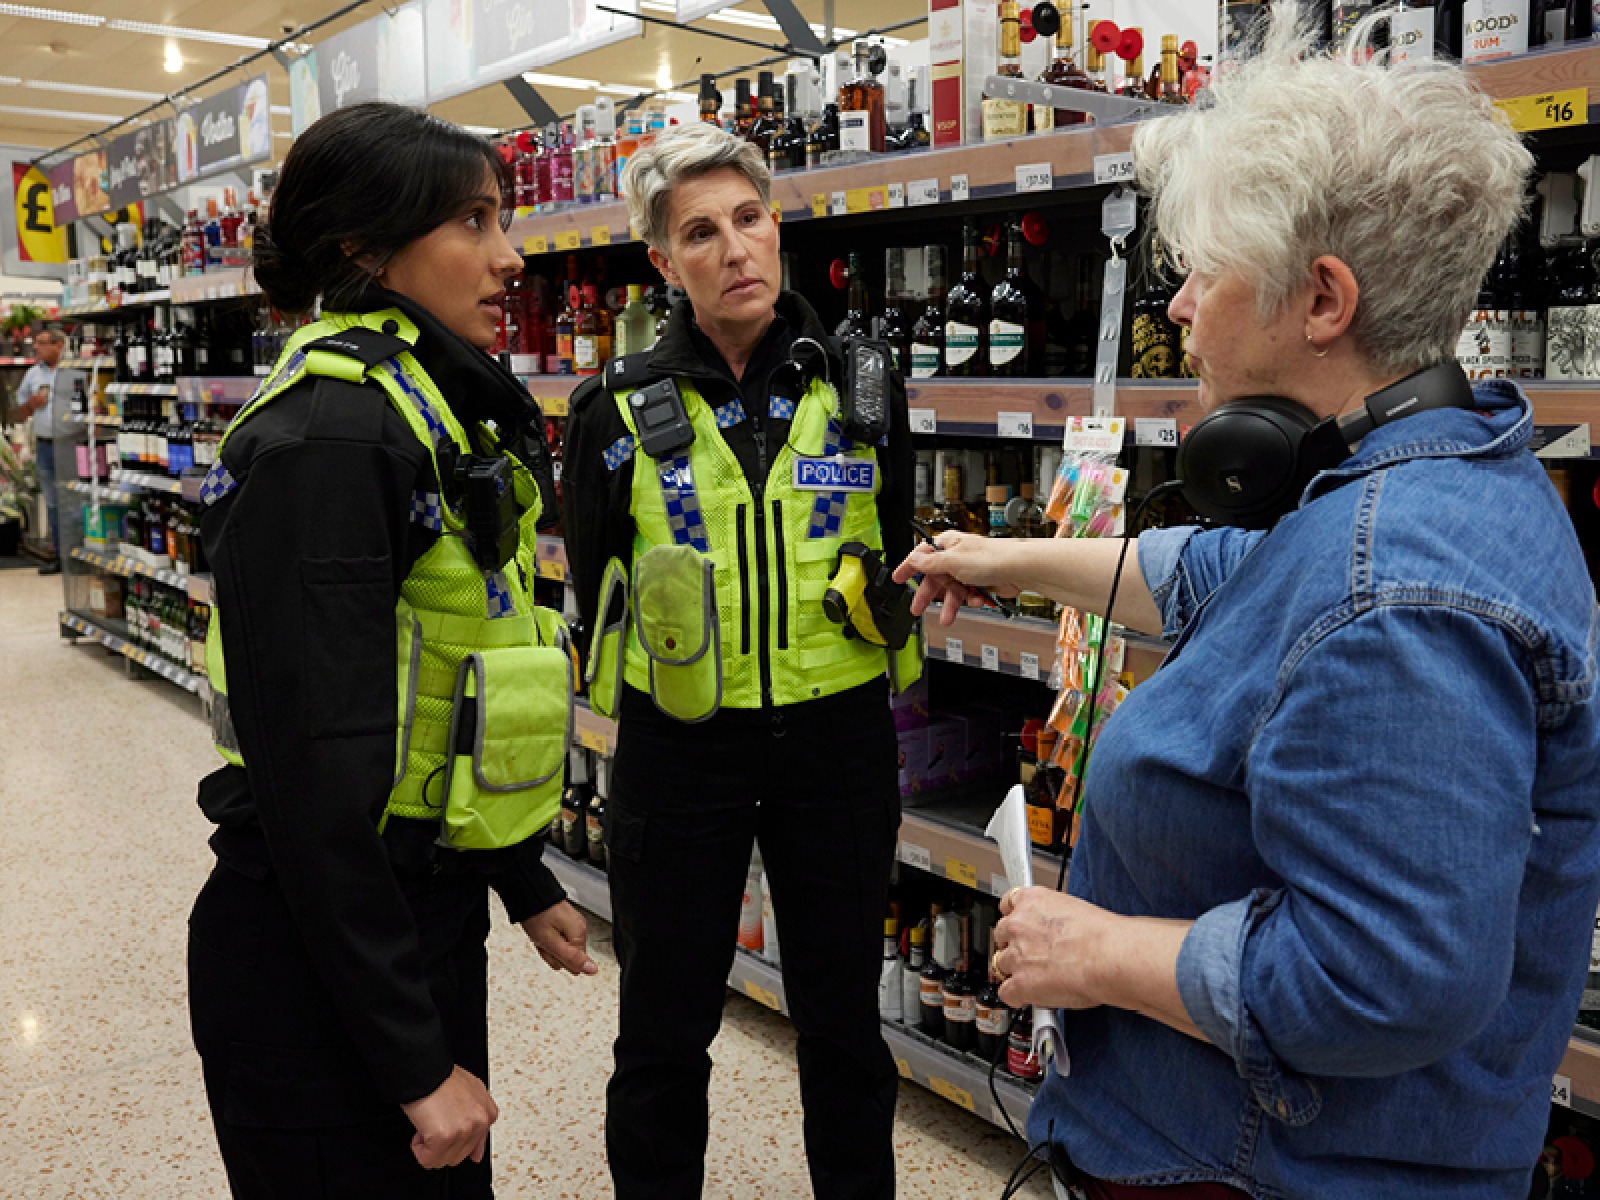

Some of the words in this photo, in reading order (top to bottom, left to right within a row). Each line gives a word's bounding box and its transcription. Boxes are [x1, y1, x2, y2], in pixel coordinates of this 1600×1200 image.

[1545, 101, 1574, 122] £16
[22, 183, 52, 233] £
[801, 463, 871, 485] POLICE
